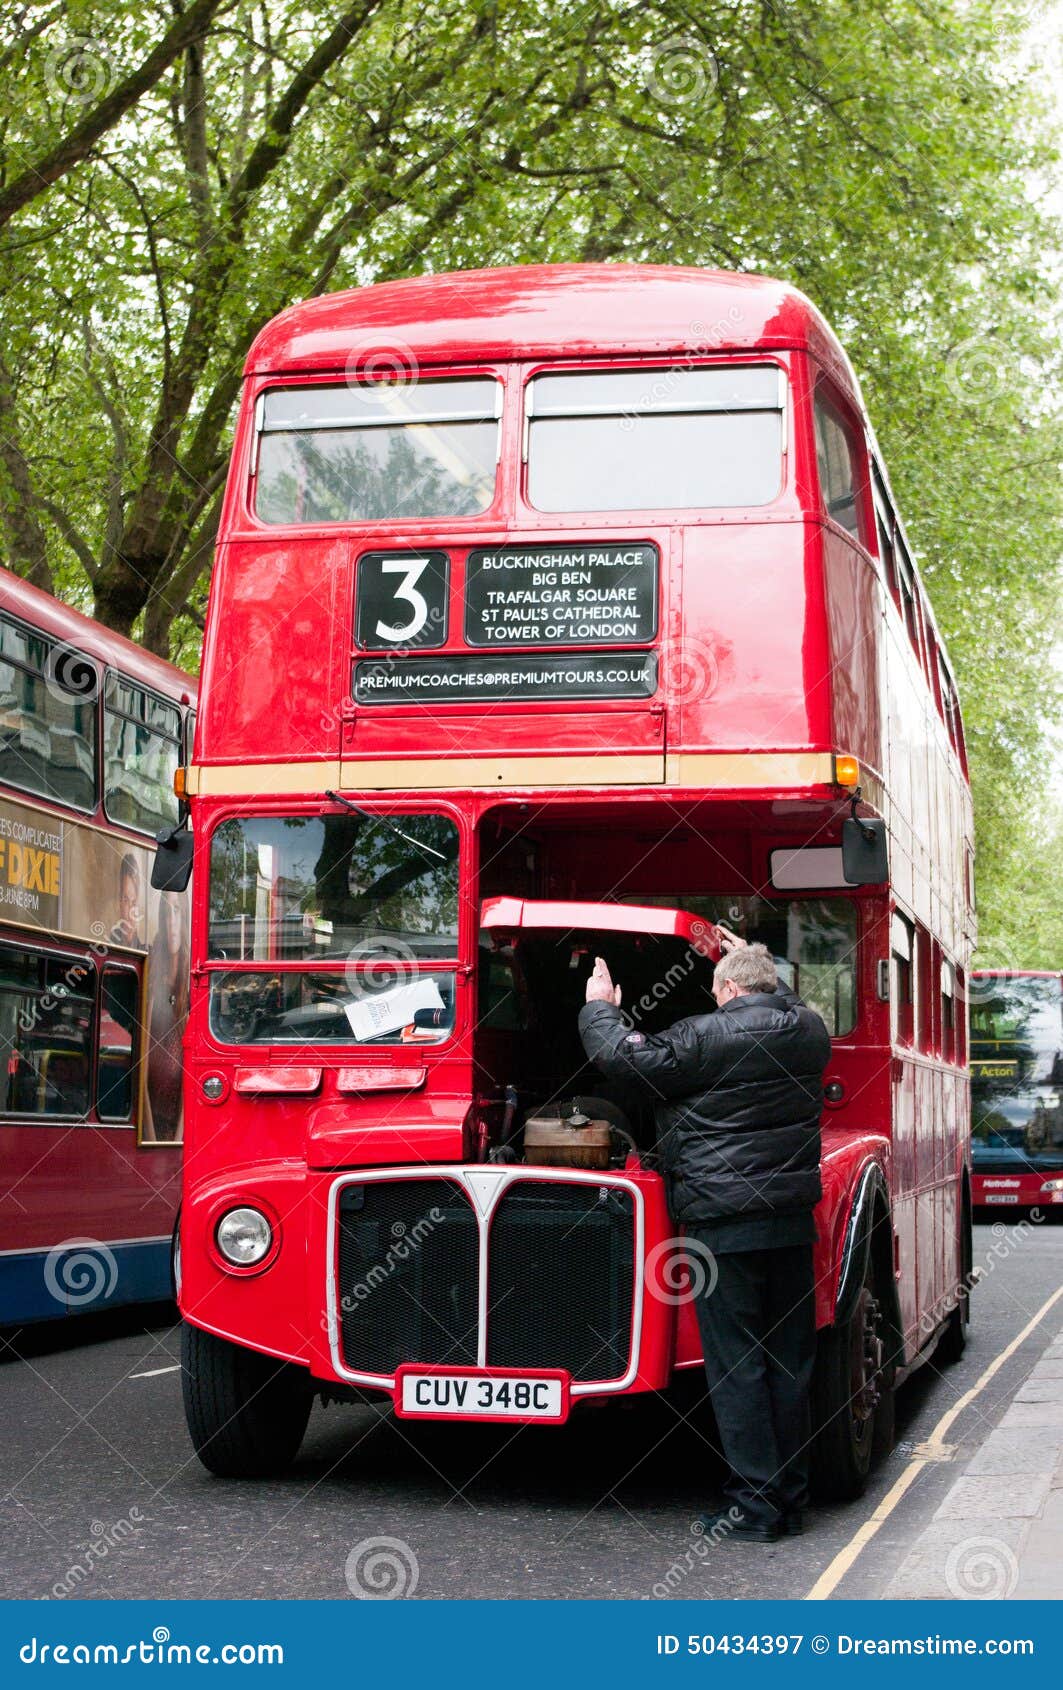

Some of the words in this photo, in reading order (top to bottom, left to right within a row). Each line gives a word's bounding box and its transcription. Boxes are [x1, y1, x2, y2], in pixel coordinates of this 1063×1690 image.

[482, 553, 585, 570] BUCKINGHAM
[588, 552, 643, 567] PALACE
[532, 572, 558, 586] BIG
[561, 571, 591, 585] BEN
[375, 559, 430, 642] 3
[487, 590, 571, 605] TRAFALGAR
[576, 588, 637, 603] SQUARE
[481, 608, 500, 622] ST
[503, 607, 549, 621] PAUL'S
[552, 606, 641, 620] CATHEDRAL
[485, 625, 541, 640] TOWER
[544, 625, 565, 638] OF
[569, 624, 637, 638] LONDON
[360, 669, 651, 688] PREMIUMCOACHES@PREMIUMTOURS.CO.UK
[12, 821, 62, 852] COMPLICATED
[8, 842, 60, 896] DIXIE
[4, 886, 23, 908] JUNE
[980, 1064, 1014, 1077] Acton
[415, 1379, 469, 1407] CUV
[477, 1381, 549, 1410] 348C
